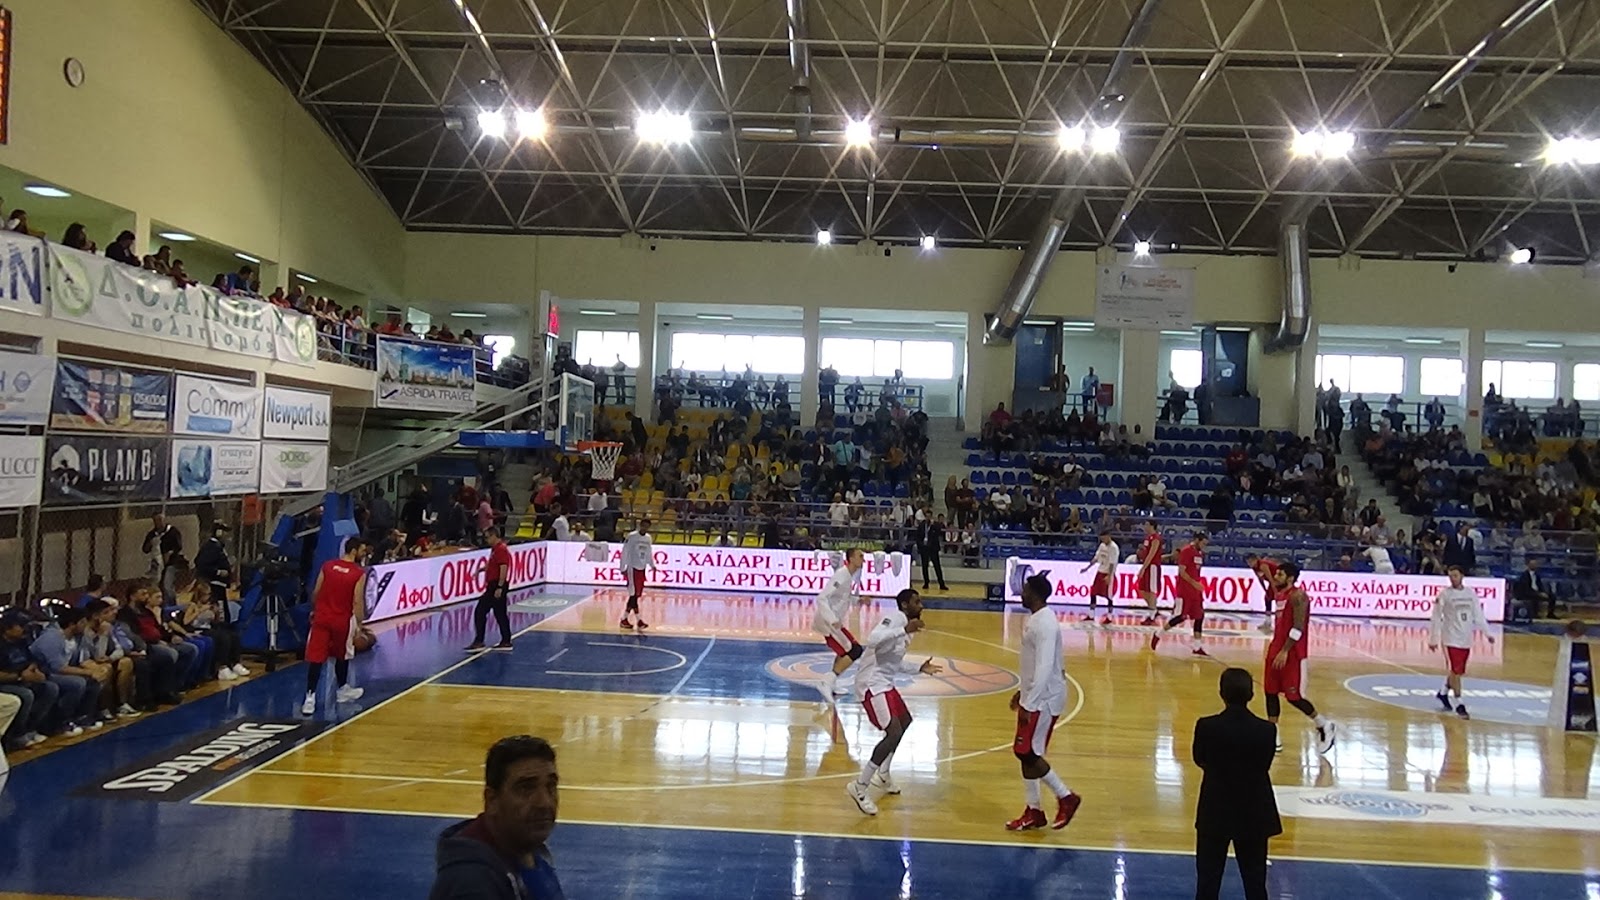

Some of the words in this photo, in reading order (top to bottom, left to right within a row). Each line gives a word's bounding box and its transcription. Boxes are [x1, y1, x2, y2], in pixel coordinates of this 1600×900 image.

[399, 386, 437, 399] ASPIDA
[439, 389, 472, 402] TRAVEL
[266, 397, 313, 430] Newport
[688, 550, 771, 569] ΧΑΪΔΑΡΙ
[440, 547, 548, 601] ΟΙΚΟΜΟΥ
[594, 567, 703, 585] ΚΕΤΣΙΝΙ
[102, 722, 301, 792] SPALDING
